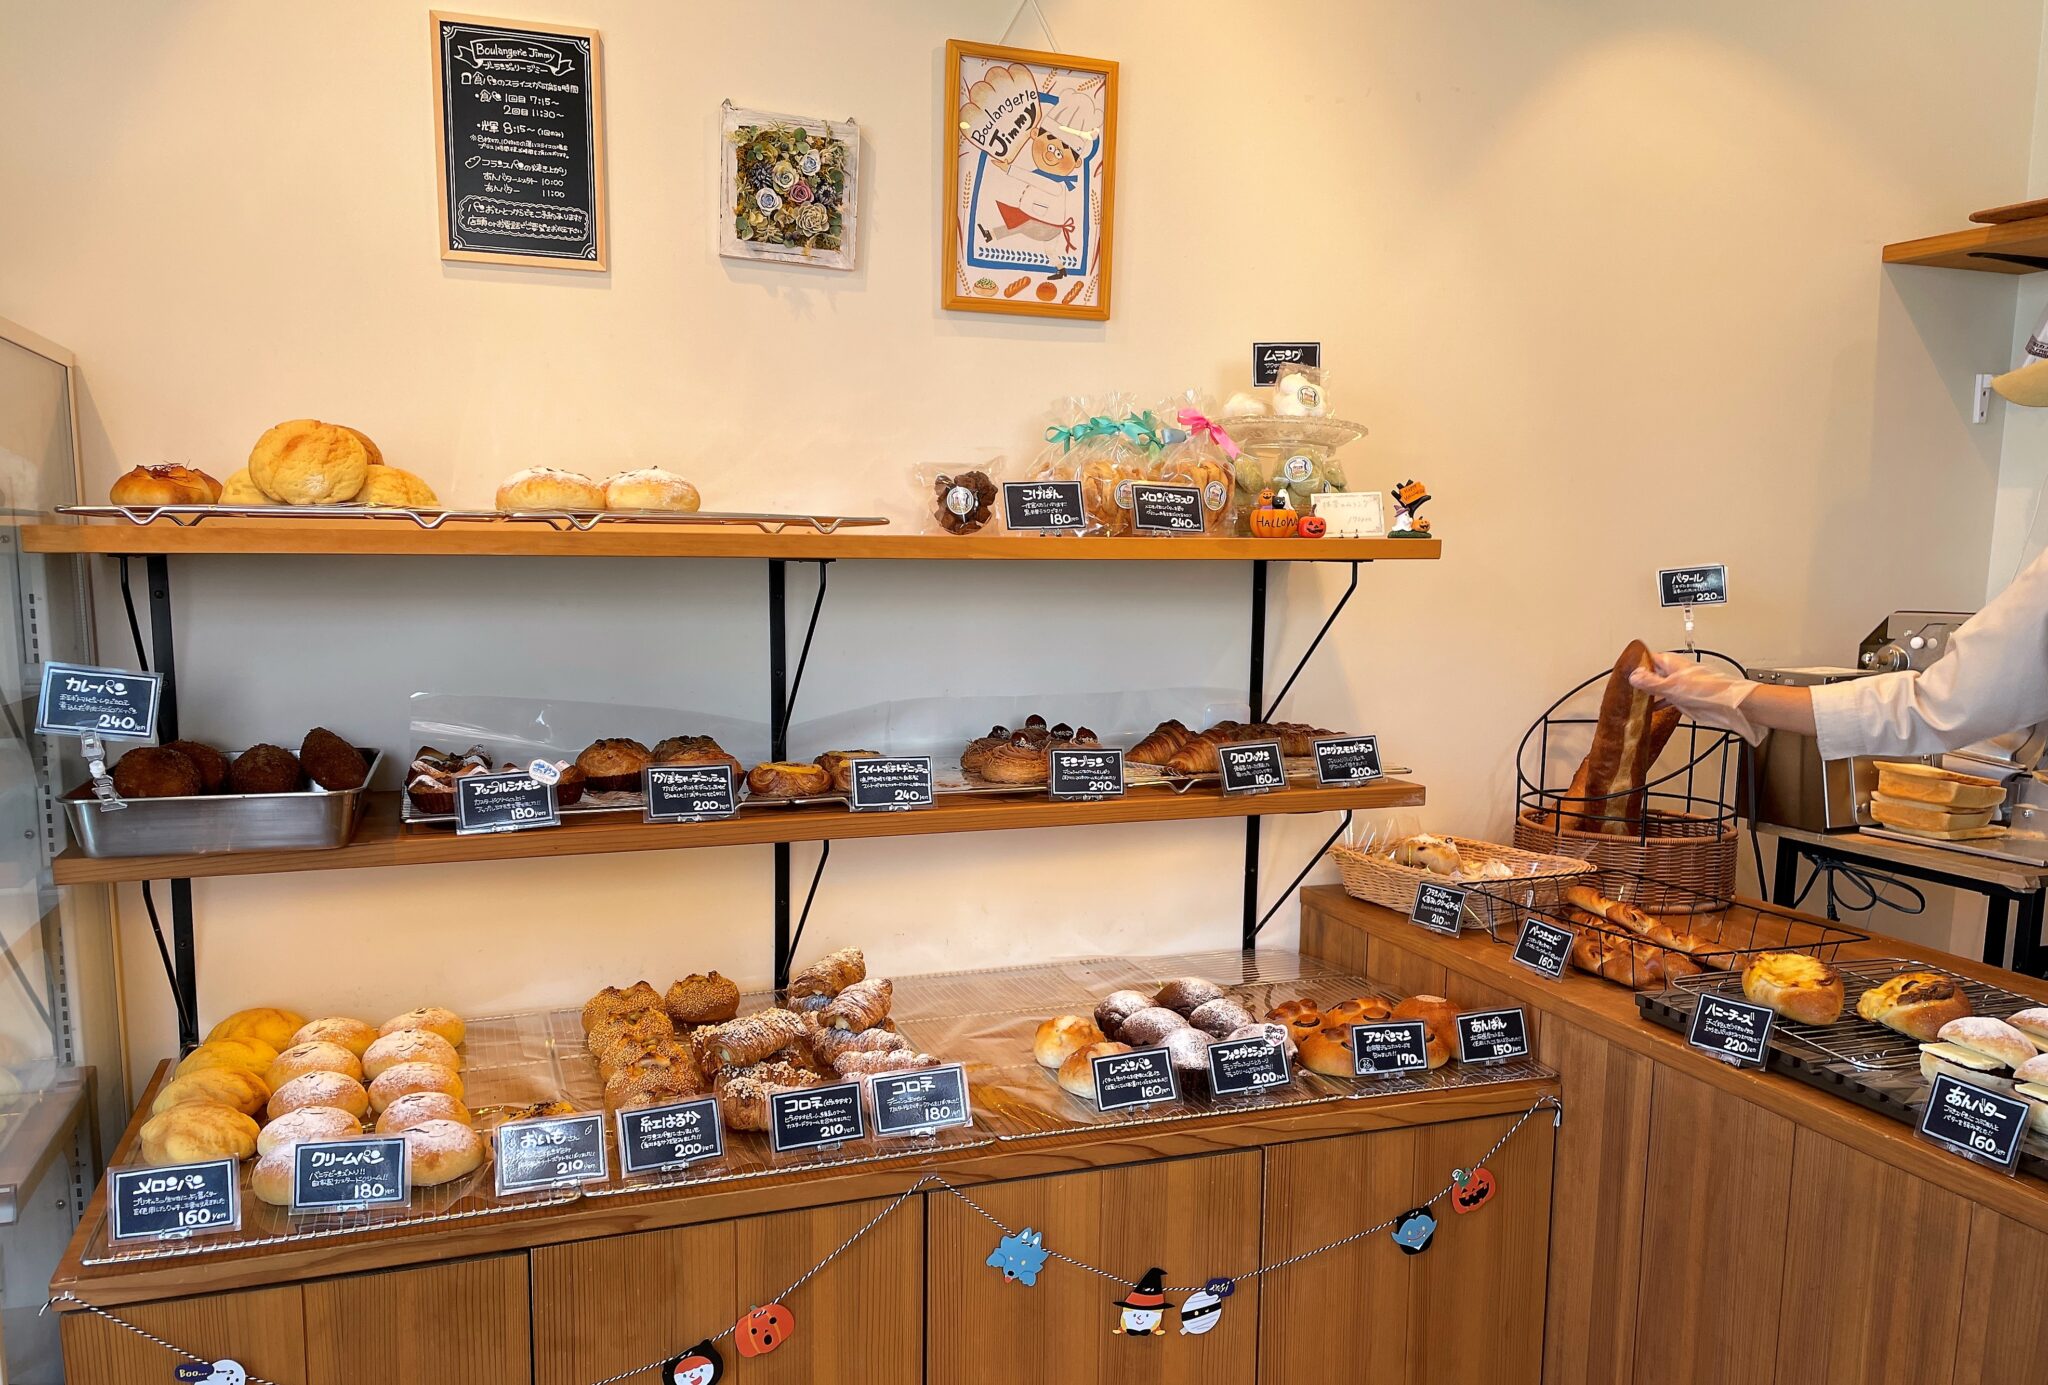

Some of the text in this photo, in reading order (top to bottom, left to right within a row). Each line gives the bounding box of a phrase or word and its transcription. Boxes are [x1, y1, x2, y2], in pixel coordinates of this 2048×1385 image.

[476, 43, 555, 63] Boulangerie Jimmy
[971, 88, 1038, 147] Boulangerie
[988, 102, 1038, 158] Jimmy
[542, 177, 564, 187] 10:00
[542, 189, 566, 198] 11:00
[1264, 348, 1304, 362] ムラング
[1022, 486, 1063, 501] こげぱん
[1140, 491, 1195, 505] メロンパンラスク
[65, 677, 128, 696] カレーパン
[1230, 750, 1270, 765] クロワッサン
[1319, 741, 1373, 756] ロングアーモンドチョコ
[858, 762, 930, 774] スイートポテトデニッシュ
[1060, 755, 1105, 767] モンブラン
[469, 780, 542, 796] アップルシナモン
[1529, 925, 1562, 946] ベーコンエピ
[1705, 1003, 1754, 1026] ハニーチーズ
[1470, 1016, 1507, 1033] あんぱん
[1363, 1029, 1412, 1044] アンパンマン
[1218, 1044, 1275, 1062] フォンダンショコラ
[1109, 1057, 1153, 1075] レーズンパン
[891, 1076, 936, 1095] コロネ
[1945, 1086, 2008, 1119] あんバター
[640, 1110, 701, 1133] 紅はるか
[311, 1149, 385, 1168] クリームパン
[132, 1174, 206, 1195] メロンパン
